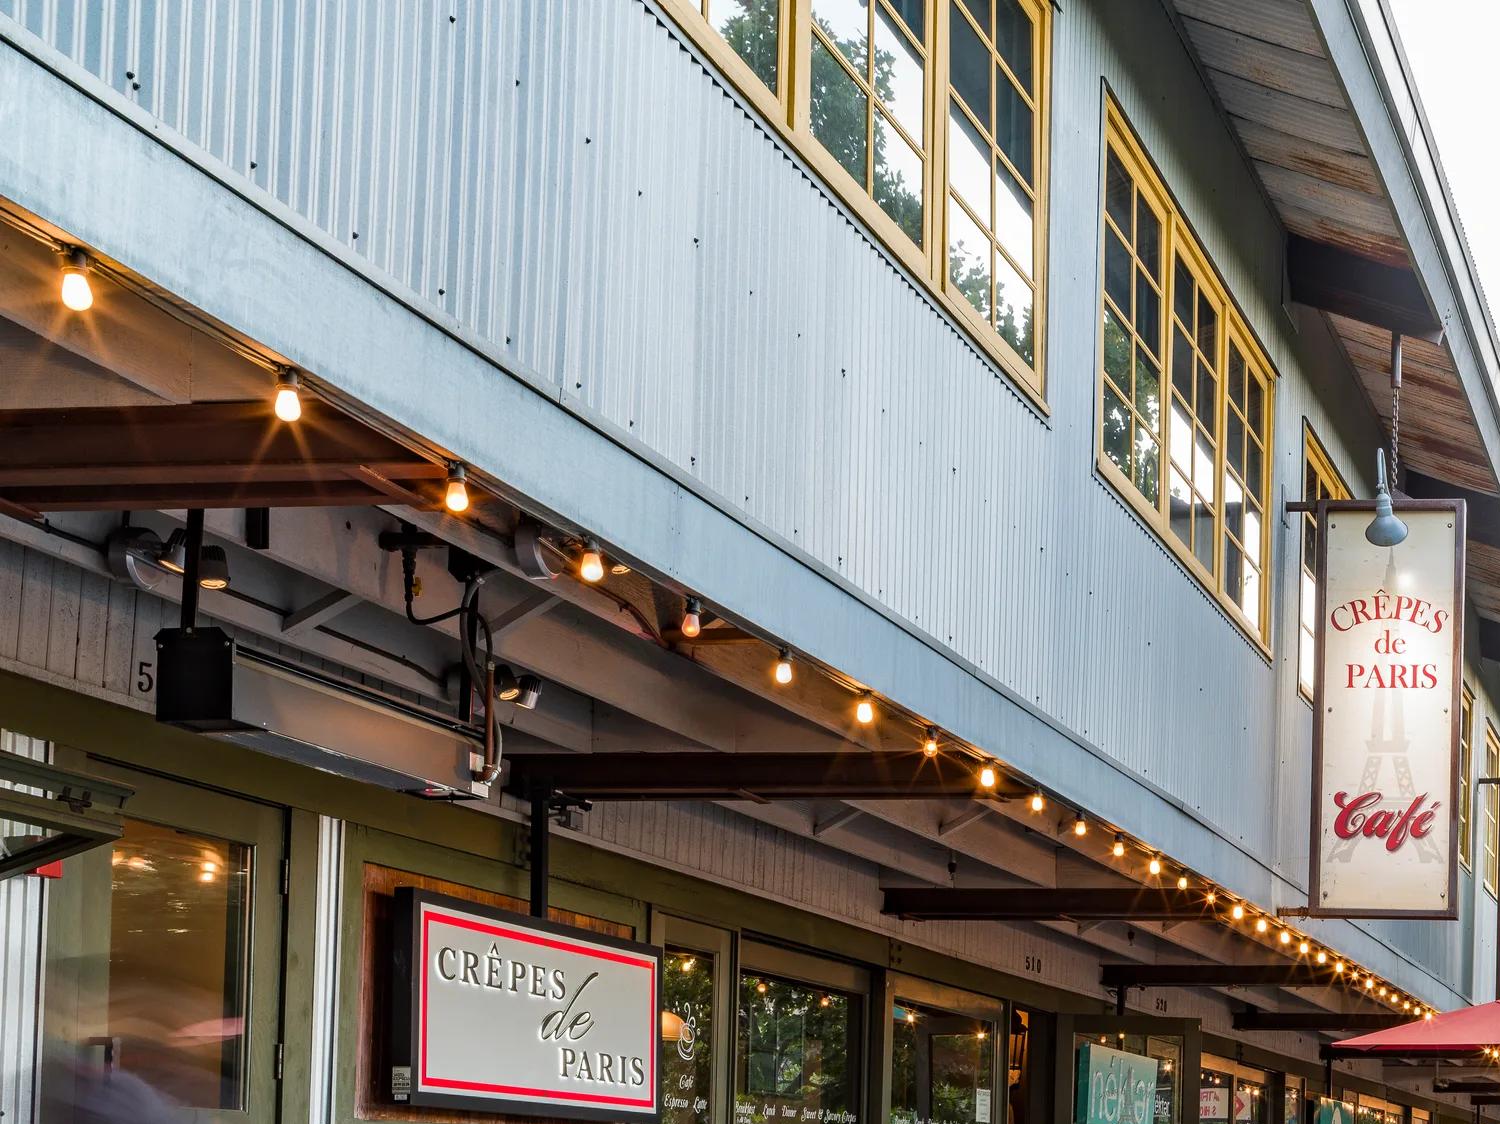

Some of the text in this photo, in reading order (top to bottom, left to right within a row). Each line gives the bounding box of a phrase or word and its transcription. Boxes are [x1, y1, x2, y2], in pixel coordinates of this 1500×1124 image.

[1330, 589, 1449, 633] CRÊPES
[1374, 629, 1407, 654] de
[1344, 663, 1438, 689] PARIS
[1333, 791, 1442, 853] Café
[437, 942, 567, 1001] CRÊPES
[1025, 955, 1042, 974] 510
[540, 971, 599, 1042] de
[560, 1047, 646, 1087] PARIS
[679, 1074, 695, 1091] Café
[663, 1093, 689, 1110] Espresso
